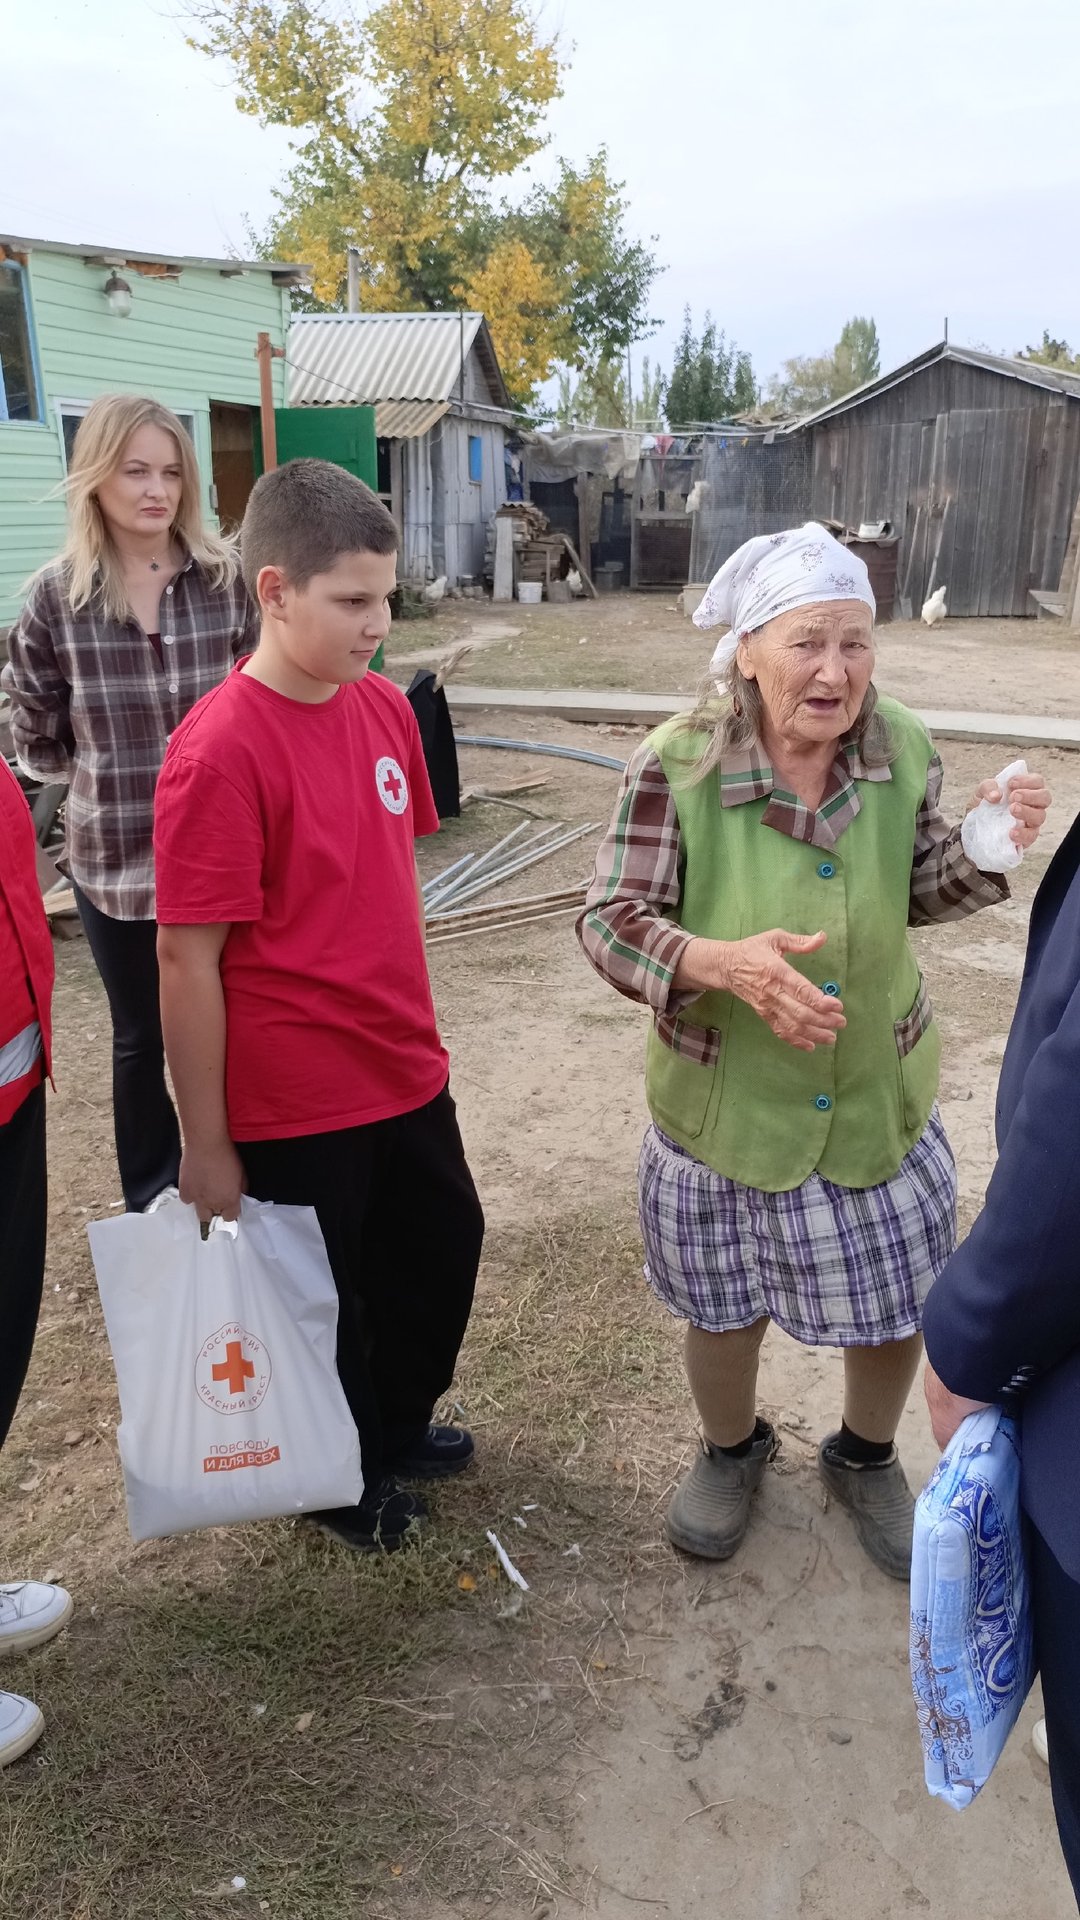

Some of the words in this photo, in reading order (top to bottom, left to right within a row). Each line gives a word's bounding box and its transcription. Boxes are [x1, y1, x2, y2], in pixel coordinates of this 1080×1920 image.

[202, 1325, 260, 1358] РОССИЙКИЙ
[200, 1383, 246, 1410] КРАСНЫЙ
[209, 1437, 271, 1456] ПОВСЮДУ
[206, 1458, 216, 1470] И
[218, 1454, 245, 1471] ДЛЯ
[247, 1448, 277, 1464] ВСЕХ
